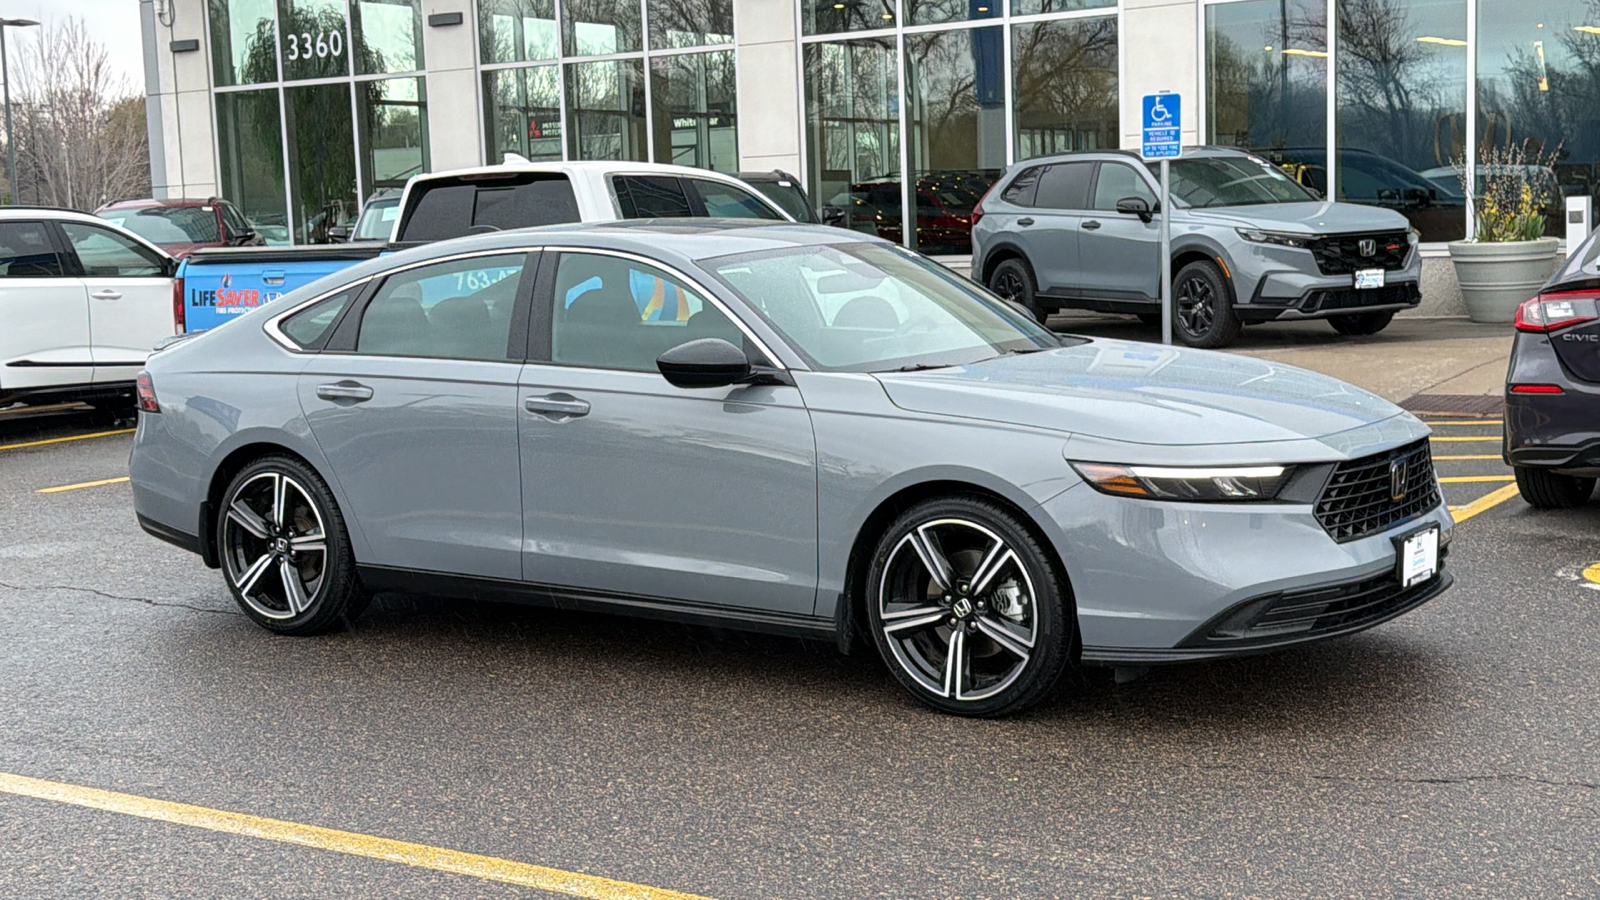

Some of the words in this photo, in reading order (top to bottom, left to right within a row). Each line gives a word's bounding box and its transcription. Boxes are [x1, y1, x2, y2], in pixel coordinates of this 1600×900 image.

[287, 29, 343, 60] 3360
[452, 269, 517, 290] 763-4
[1562, 333, 1599, 342] CIVIC
